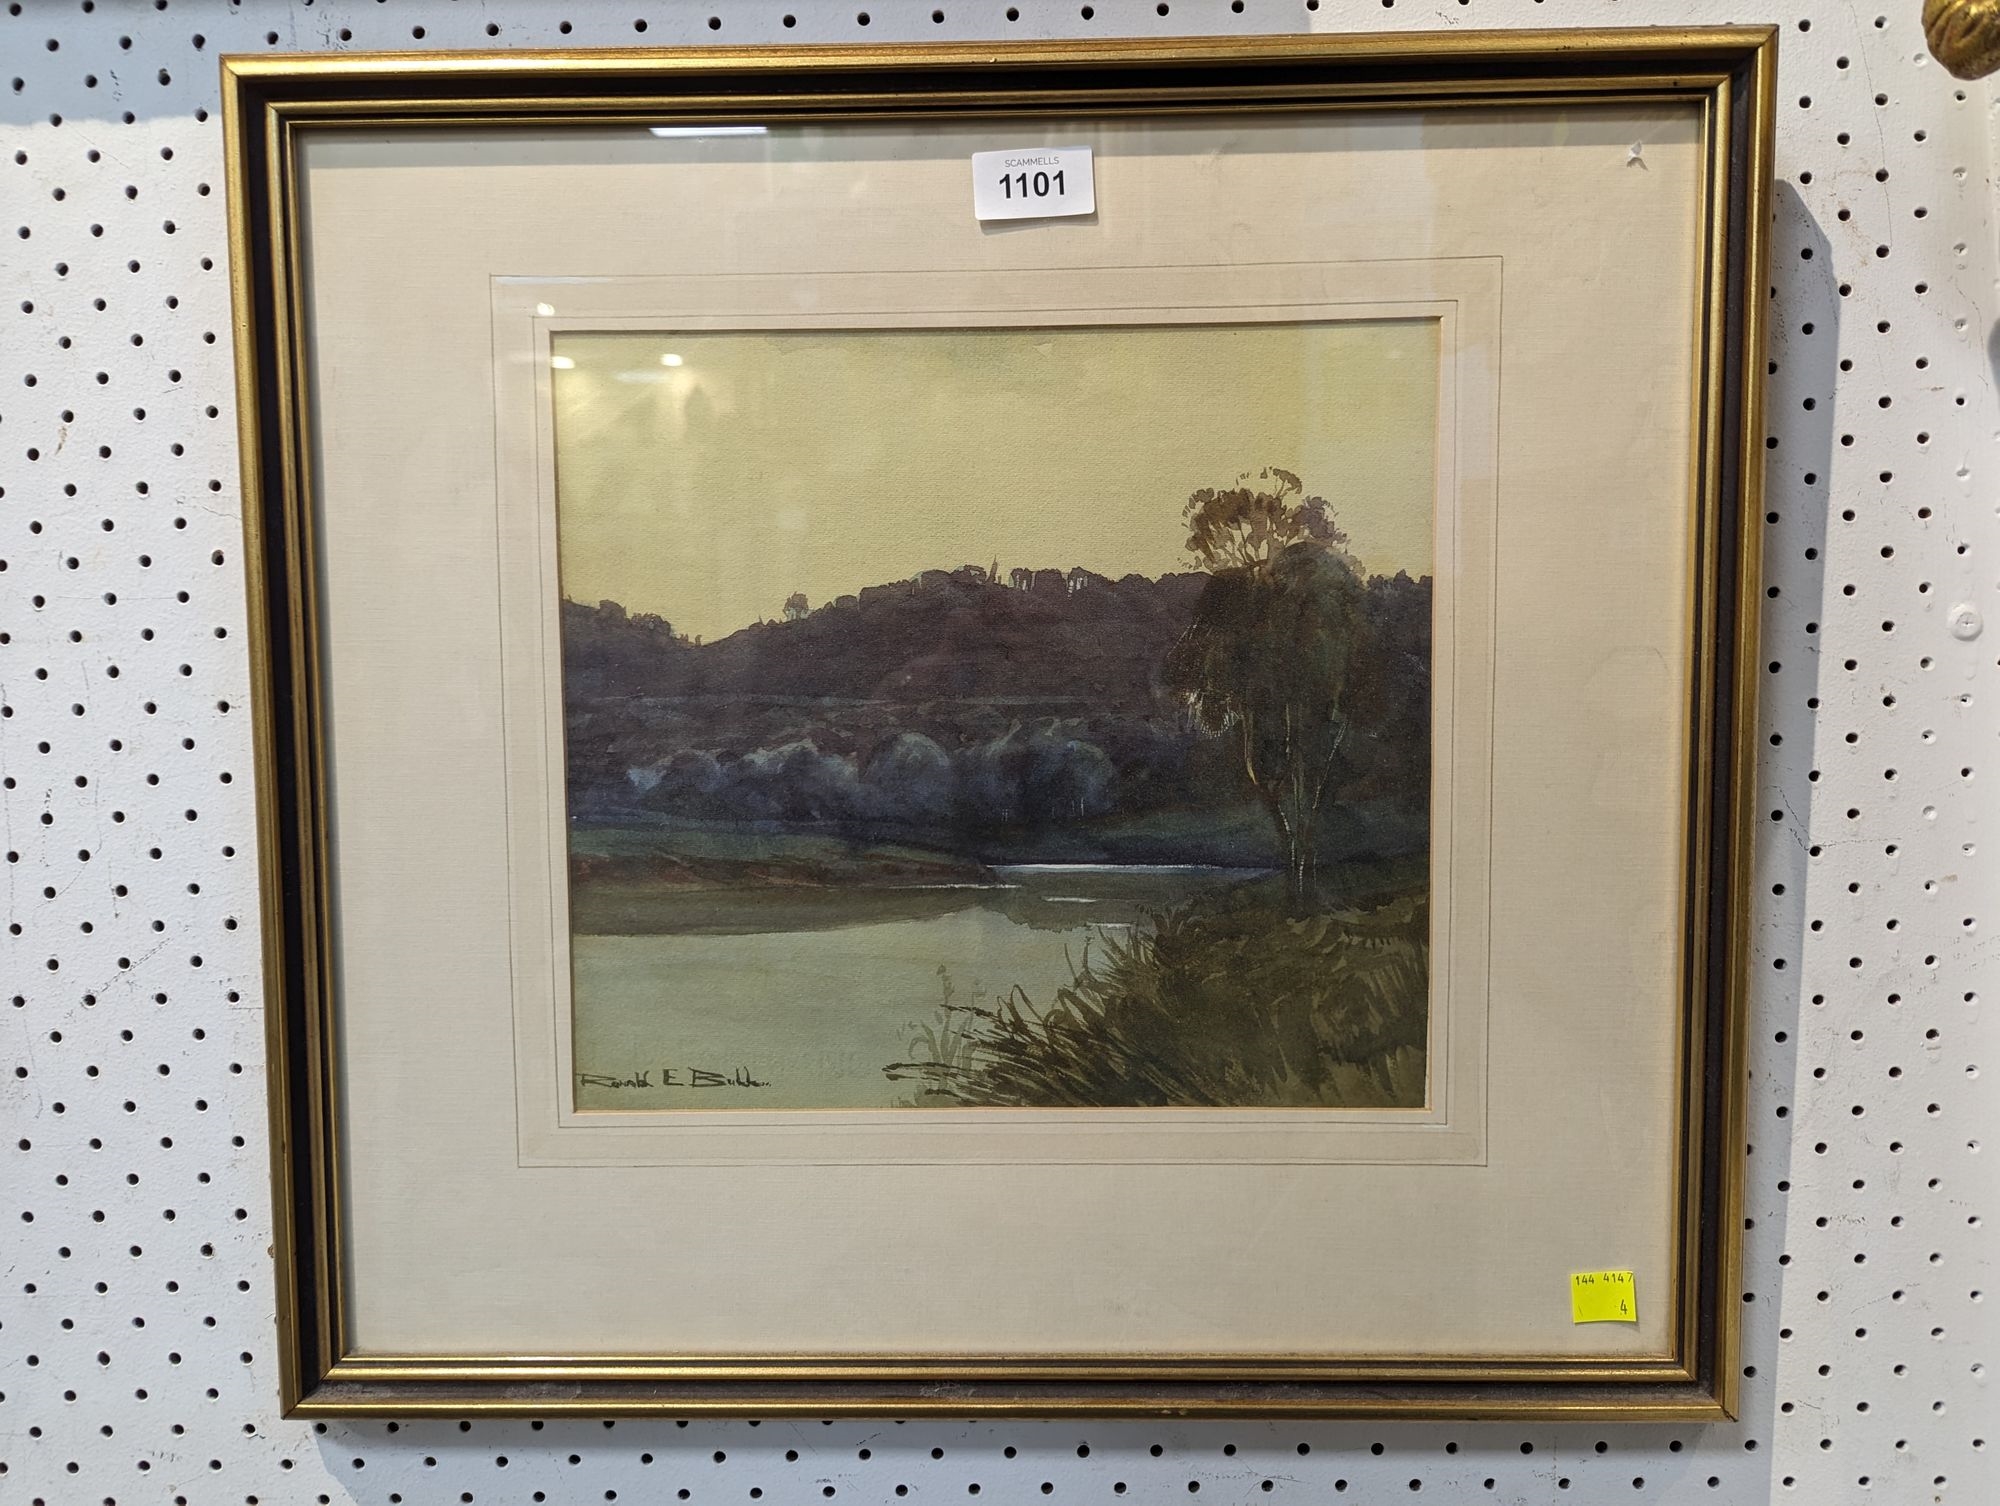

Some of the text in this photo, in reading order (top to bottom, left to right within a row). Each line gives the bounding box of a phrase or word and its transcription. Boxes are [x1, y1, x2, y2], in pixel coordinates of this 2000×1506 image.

[1004, 156, 1060, 168] SCAMMELLS
[999, 169, 1065, 199] 1101
[662, 1068, 685, 1087] E
[1575, 1271, 1634, 1287] 144 4147
[1620, 1298, 1628, 1316] 4
